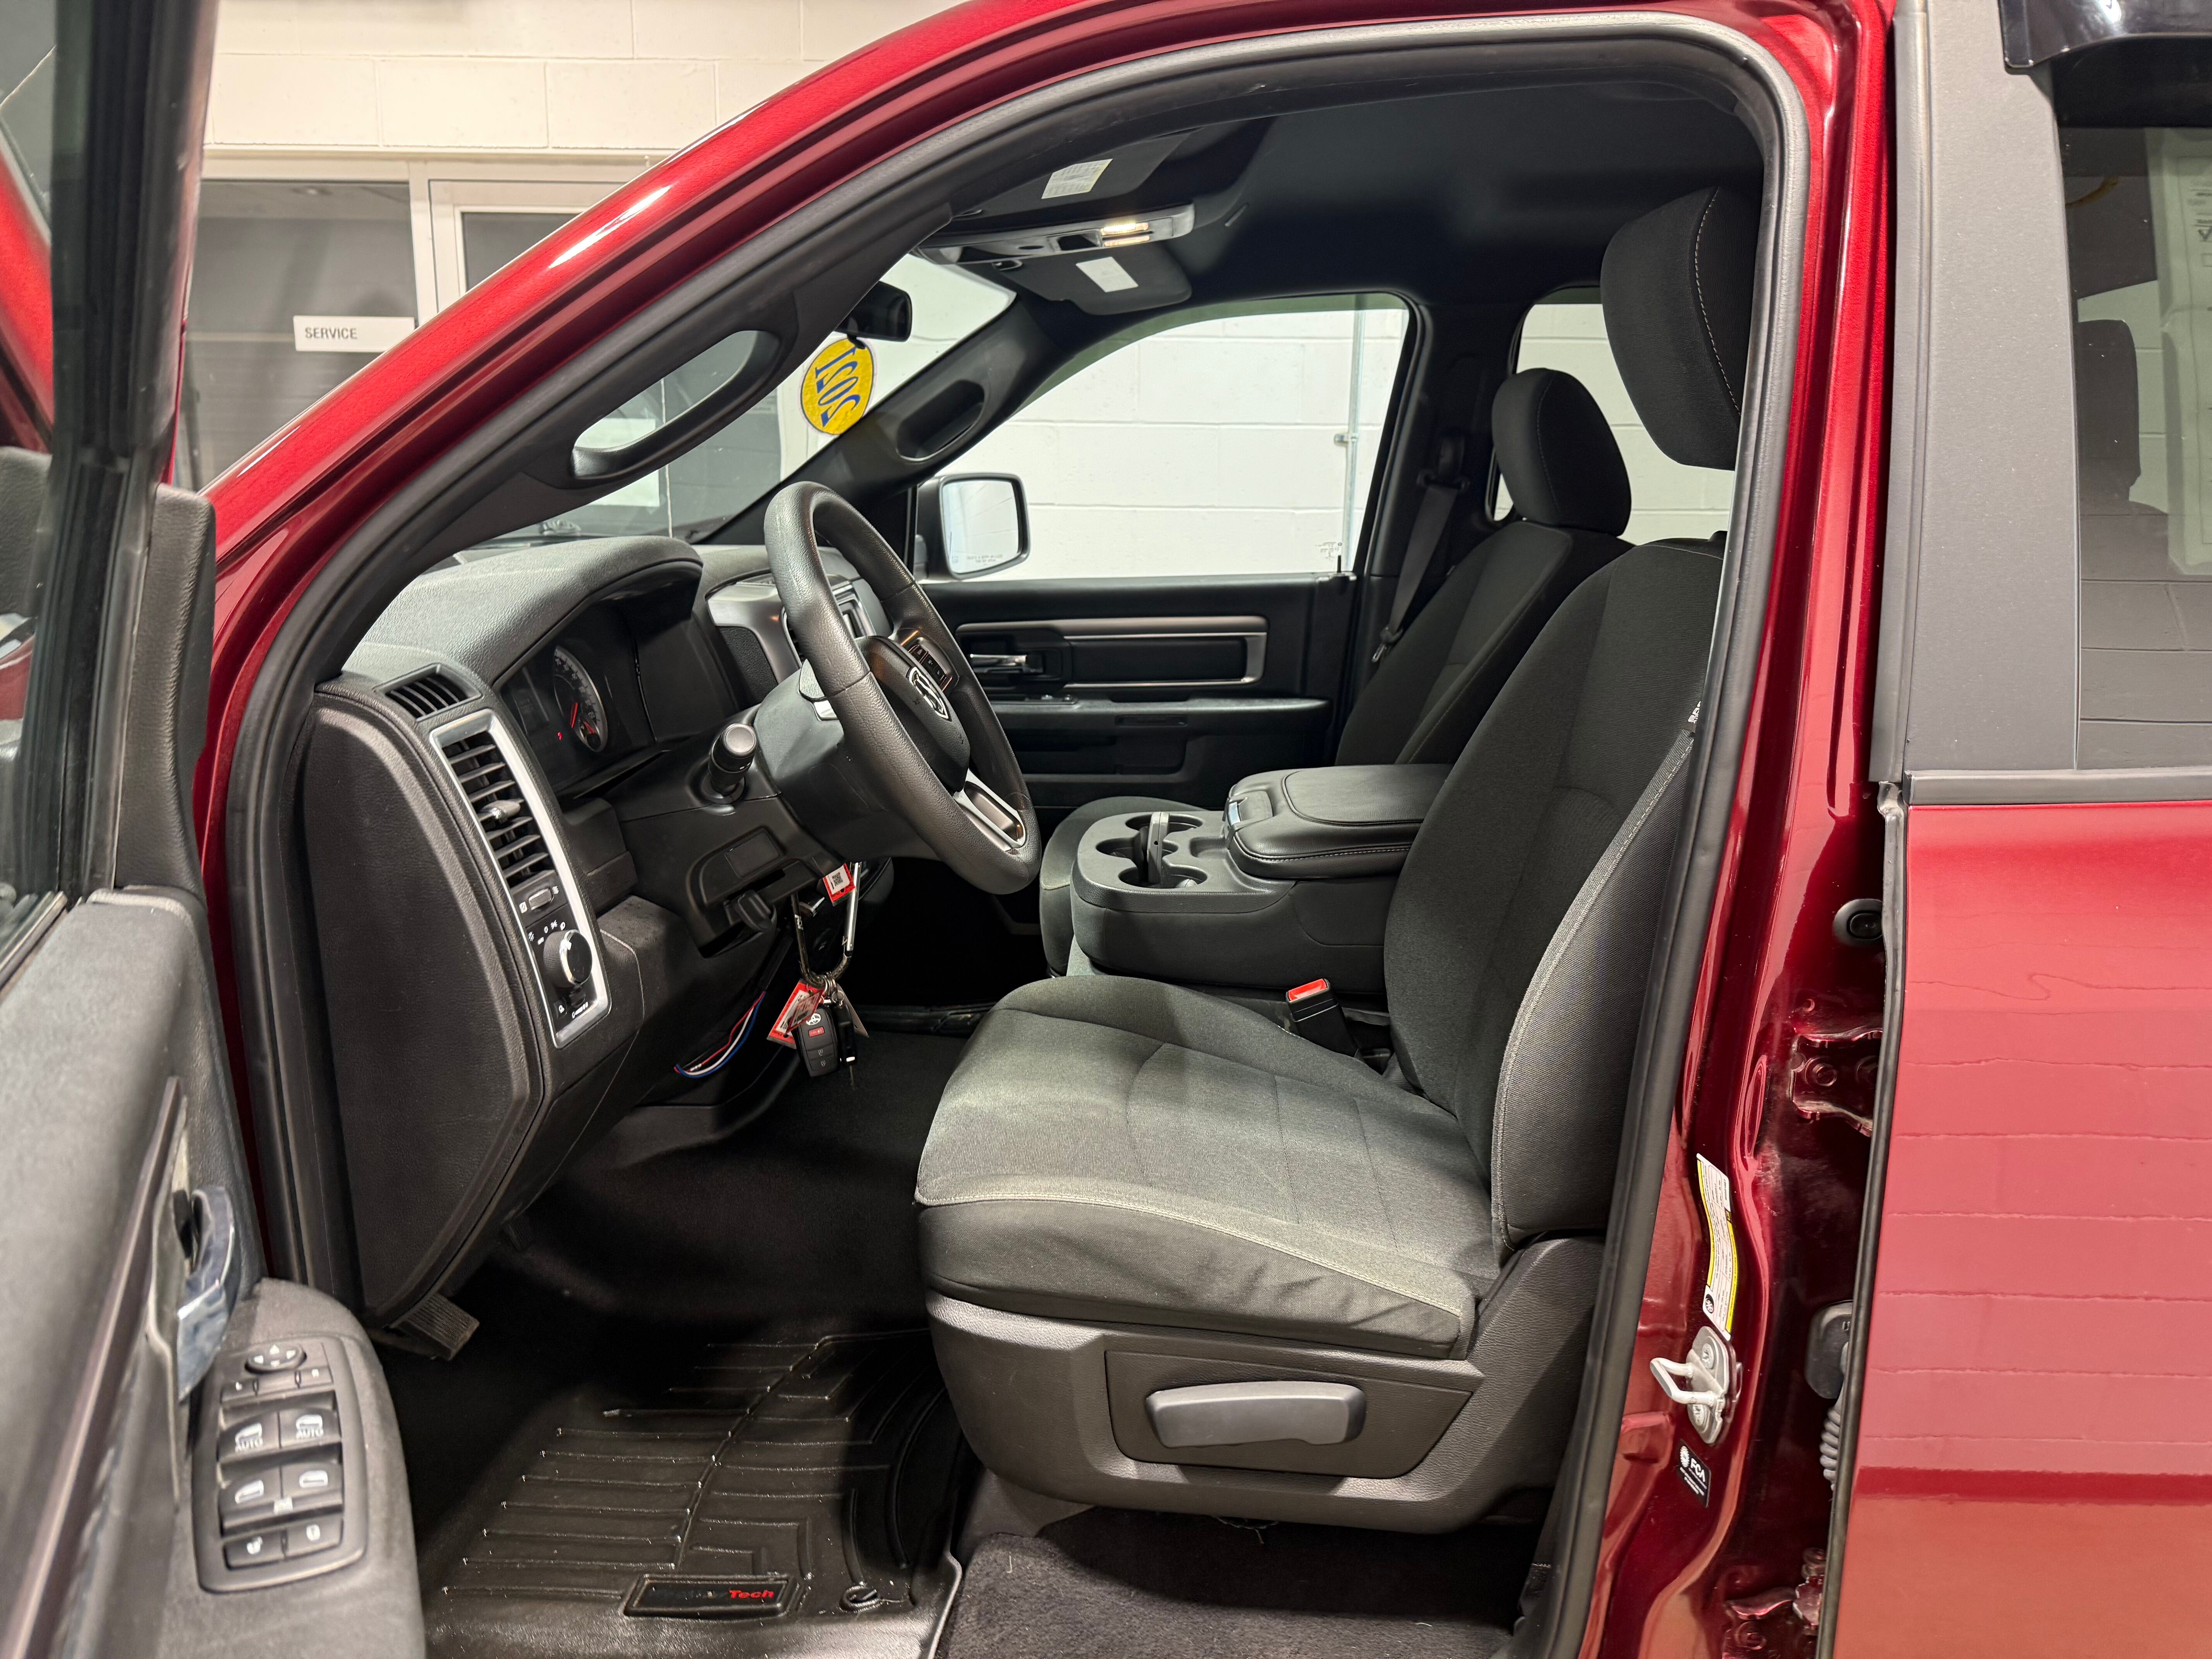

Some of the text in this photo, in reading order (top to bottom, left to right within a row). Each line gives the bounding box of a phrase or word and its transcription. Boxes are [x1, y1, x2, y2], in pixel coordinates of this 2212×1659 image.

[305, 327, 357, 340] SERVICE
[296, 1427, 324, 1440] AUTO
[235, 1437, 263, 1453] AUTO
[1690, 1458, 1706, 1482] FCA
